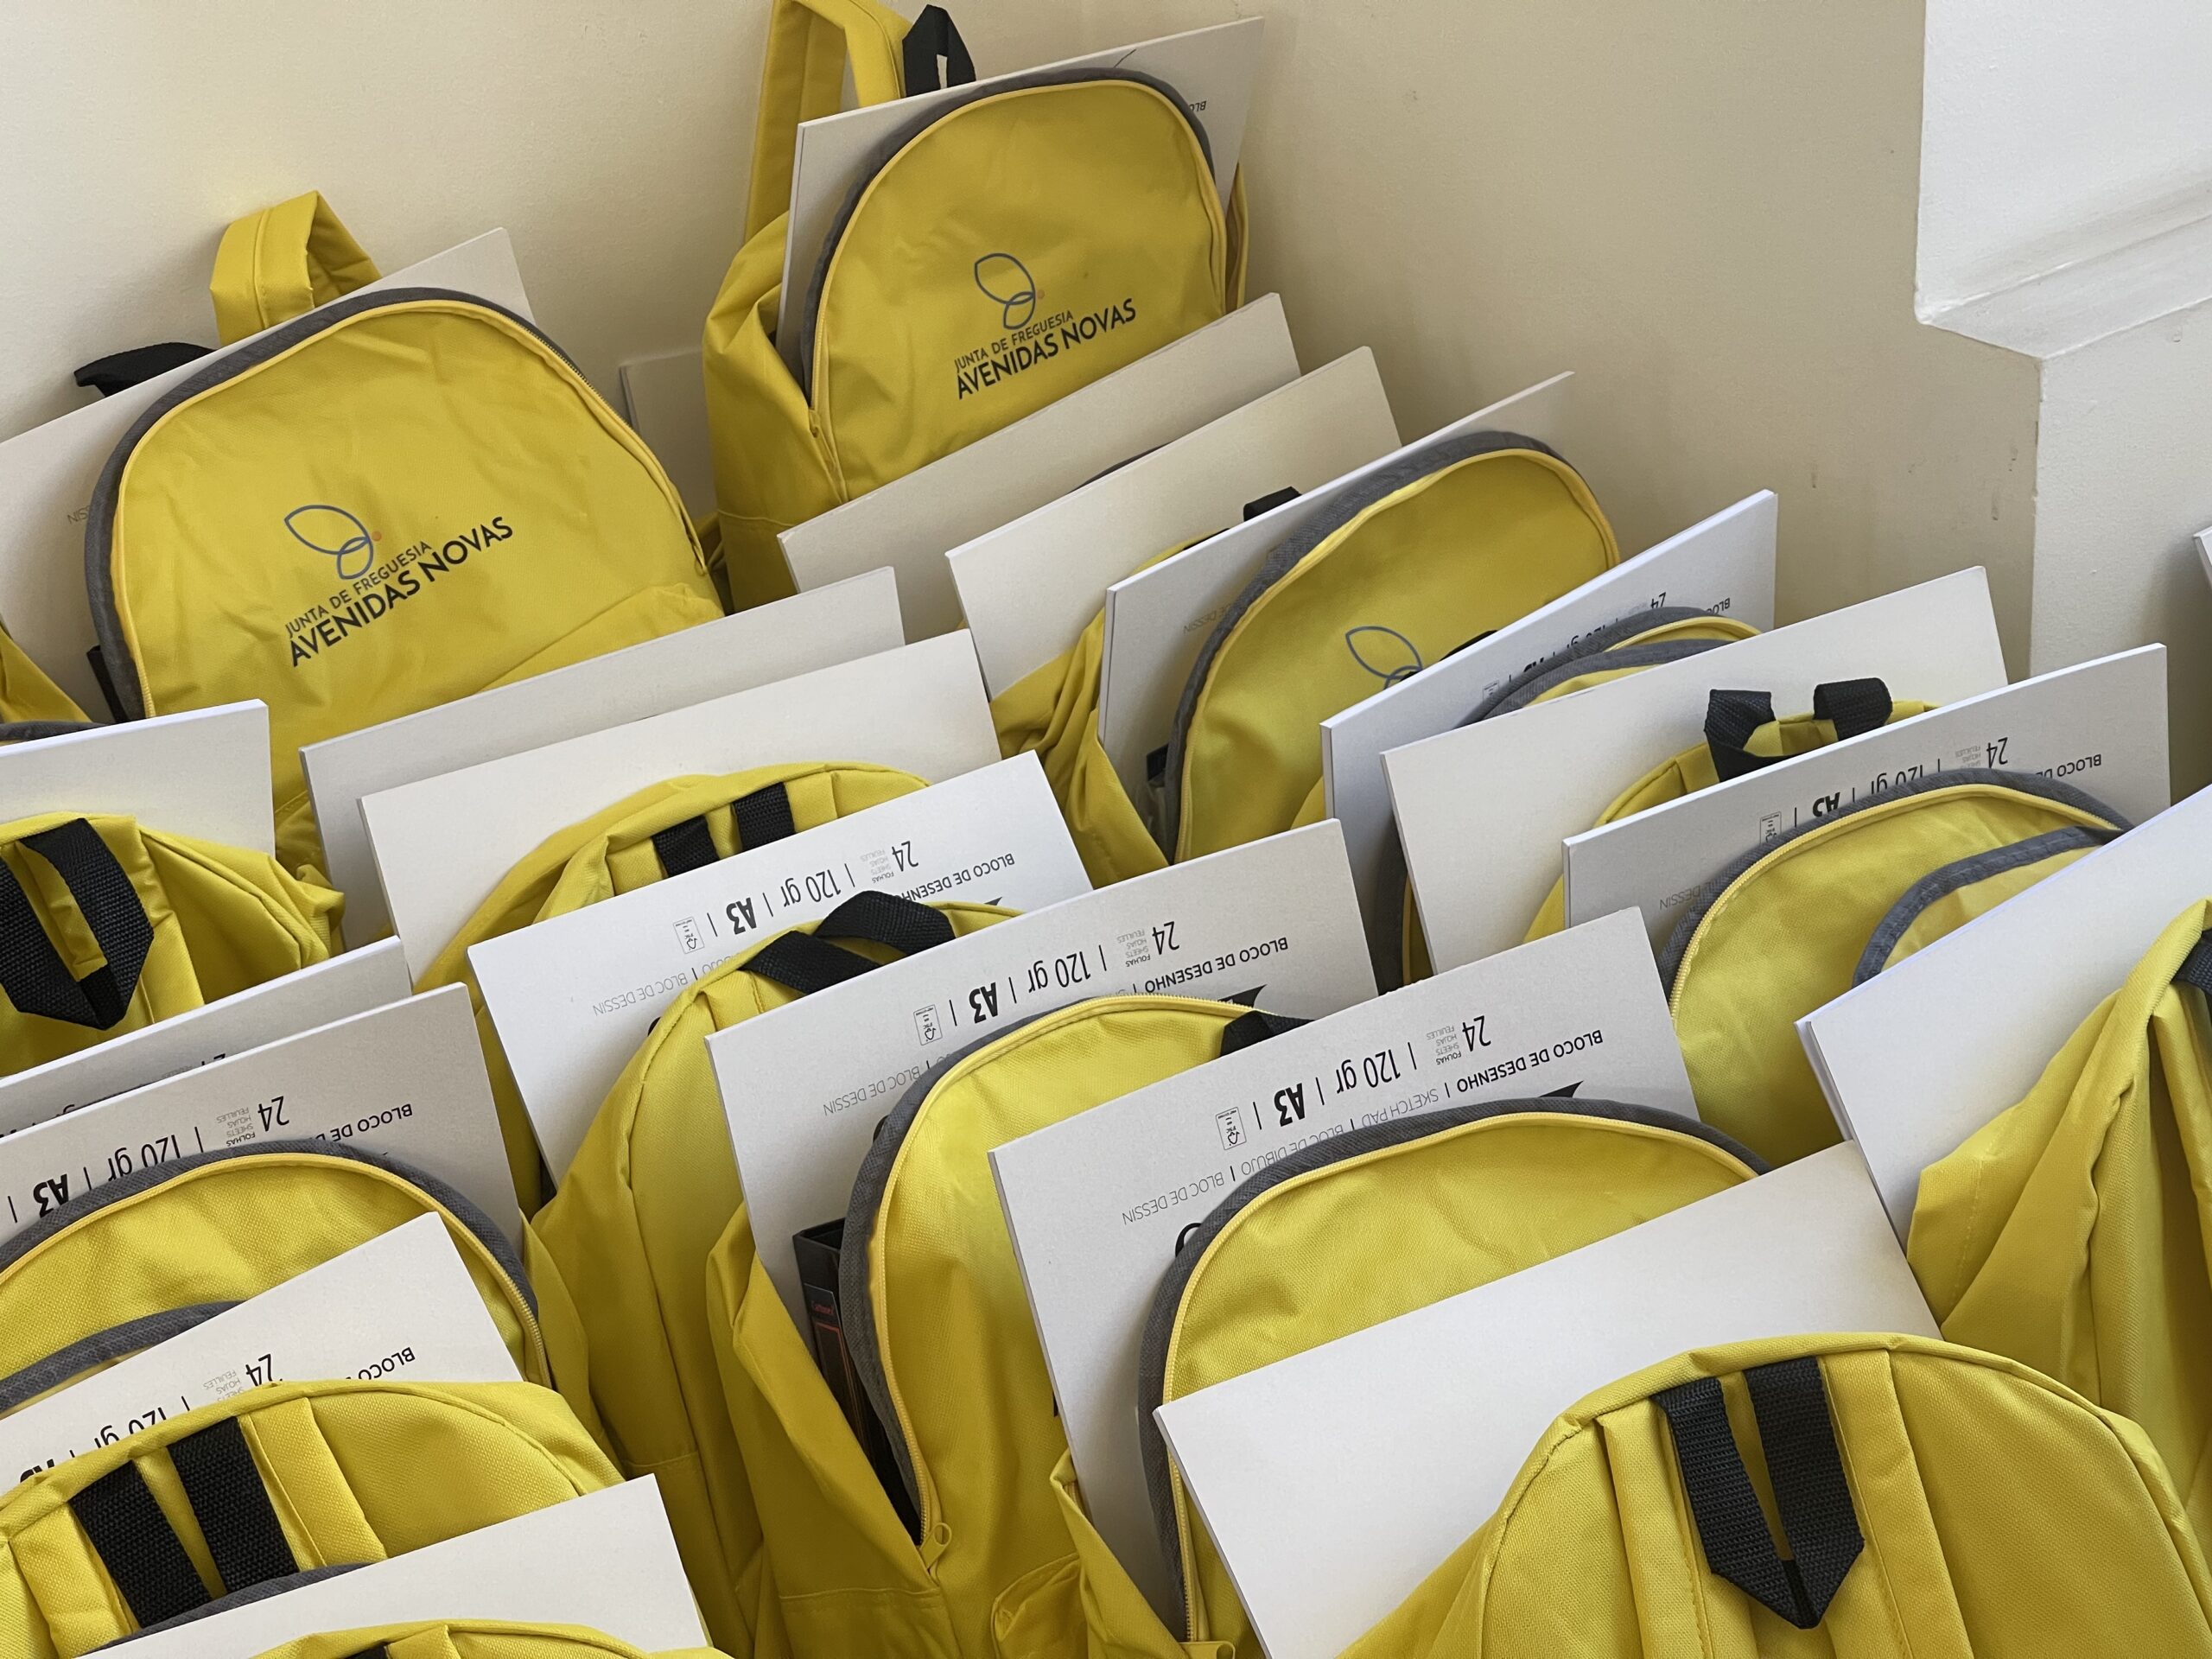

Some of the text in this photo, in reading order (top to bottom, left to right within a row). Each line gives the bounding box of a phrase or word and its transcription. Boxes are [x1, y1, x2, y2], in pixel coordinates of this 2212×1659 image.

[954, 311, 1073, 373] JUNTA DE FREGUESIA
[957, 298, 1135, 399] AVENIDAS NOVAS
[286, 541, 431, 638] JUNTA DE FREGUESIA
[290, 517, 512, 667] AVENIDAS NOVAS
[1986, 737, 2007, 770] 24
[2057, 754, 2101, 777] BLOCO
[892, 841, 918, 872] 24
[974, 854, 1014, 877] BLOCO
[806, 869, 841, 902] 120
[872, 872, 893, 883] FOLHAS
[953, 869, 971, 885] DE
[781, 878, 801, 907] gr
[1660, 885, 1701, 910] DESSIN
[727, 898, 757, 935] A3
[1152, 921, 1179, 955] 24
[1055, 951, 1090, 988] 120
[1126, 954, 1150, 967] FOLHAS
[656, 973, 689, 994] BLOC
[1028, 961, 1048, 993] gr
[593, 992, 636, 1016] DESSIN
[637, 985, 655, 1001] DE
[969, 982, 998, 1023] A3
[823, 938, 1288, 1116] BLOCO DE DESENHO BLOC DE DESSIN
[1462, 1015, 1491, 1052] 24
[1436, 1051, 1461, 1065] FOLHAS
[1529, 1049, 1549, 1067] DE
[1554, 1030, 1603, 1058] BLOCO
[1336, 1059, 1357, 1094] gr
[1363, 1049, 1401, 1088] 120
[1457, 1057, 1527, 1092] DESENHO
[257, 1096, 289, 1131] 24
[358, 1104, 412, 1132] BLOCO
[1274, 1083, 1305, 1127] A3
[1359, 1107, 1388, 1127] PAD
[1389, 1089, 1439, 1117] SKETCH
[226, 1132, 255, 1148] FOLHAS
[329, 1123, 353, 1141] DE
[107, 1146, 134, 1181] gr
[33, 1173, 73, 1217] A3
[1169, 1187, 1188, 1205] DE
[1190, 1173, 1224, 1197] BLOC
[1122, 1196, 1167, 1224] DESSIN
